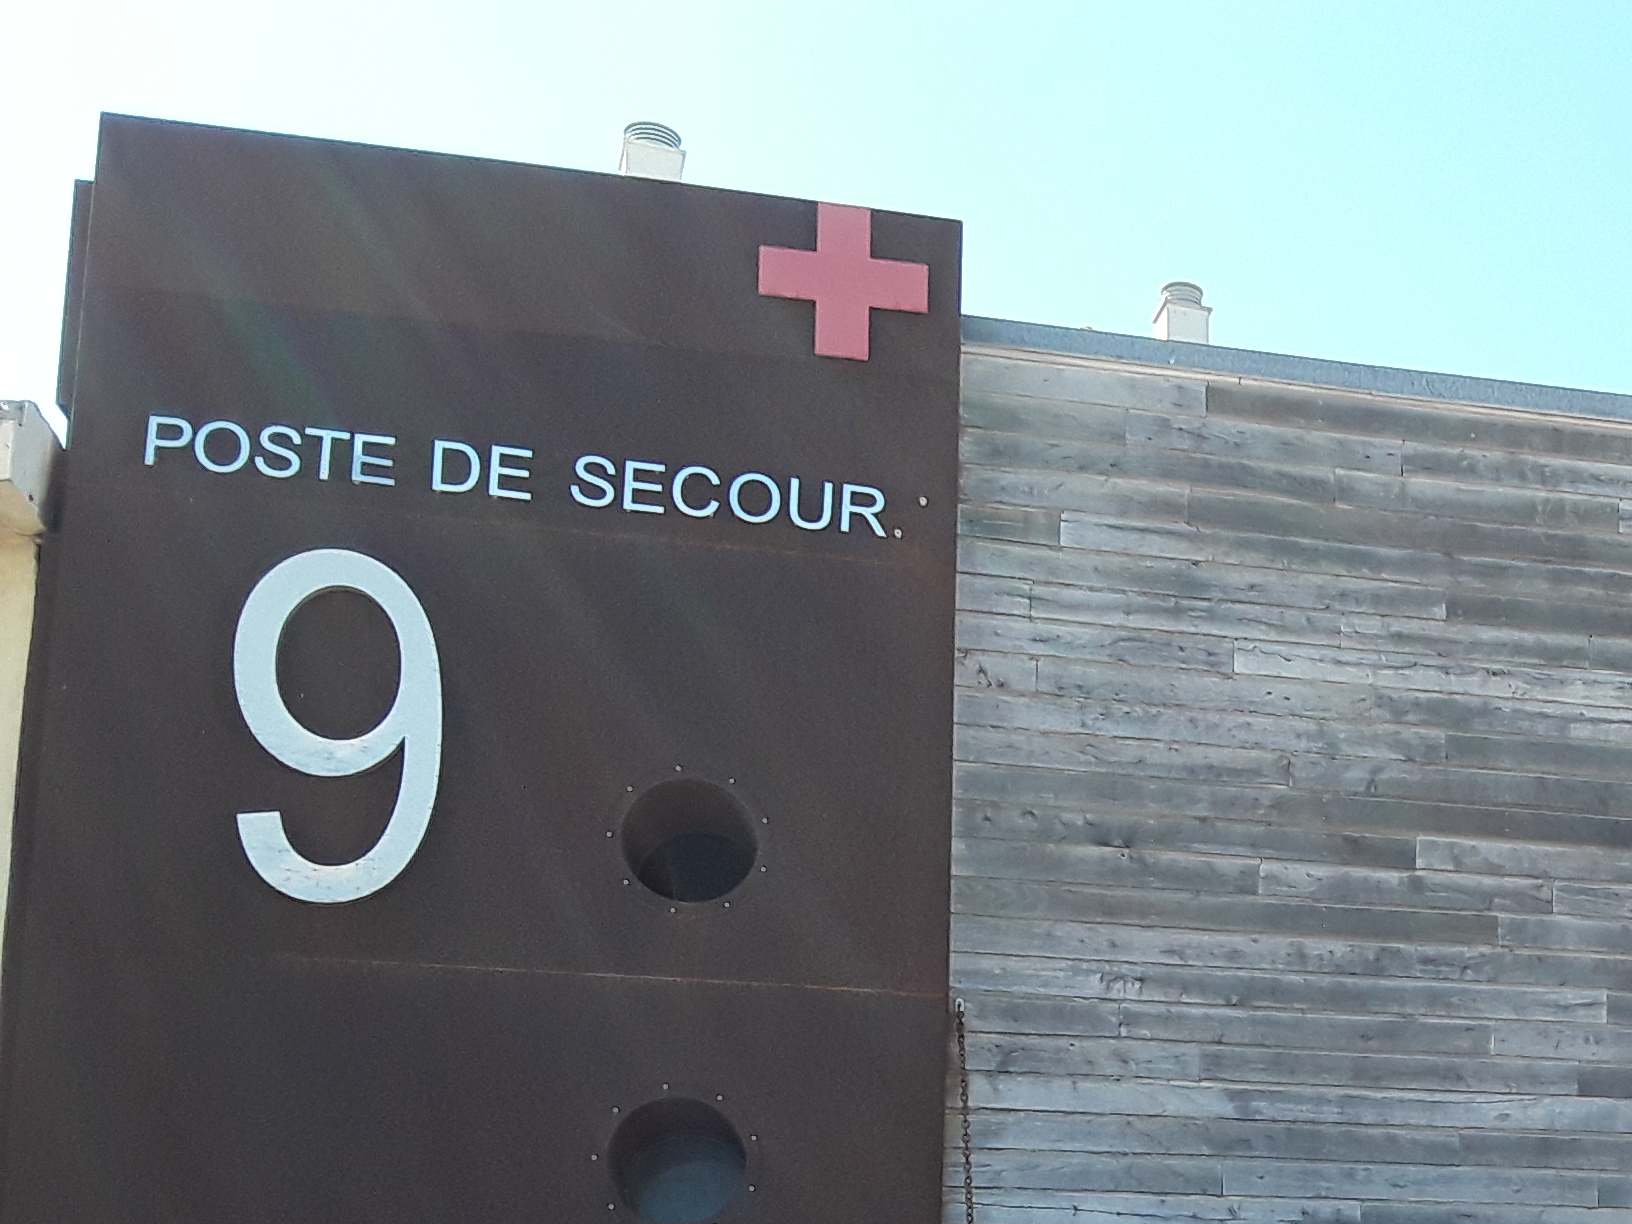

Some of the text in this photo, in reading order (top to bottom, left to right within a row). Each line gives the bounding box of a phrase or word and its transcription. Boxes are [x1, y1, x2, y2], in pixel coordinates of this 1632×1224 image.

[144, 413, 397, 488] POSTE
[431, 438, 535, 502] DE
[232, 548, 444, 905] 9
